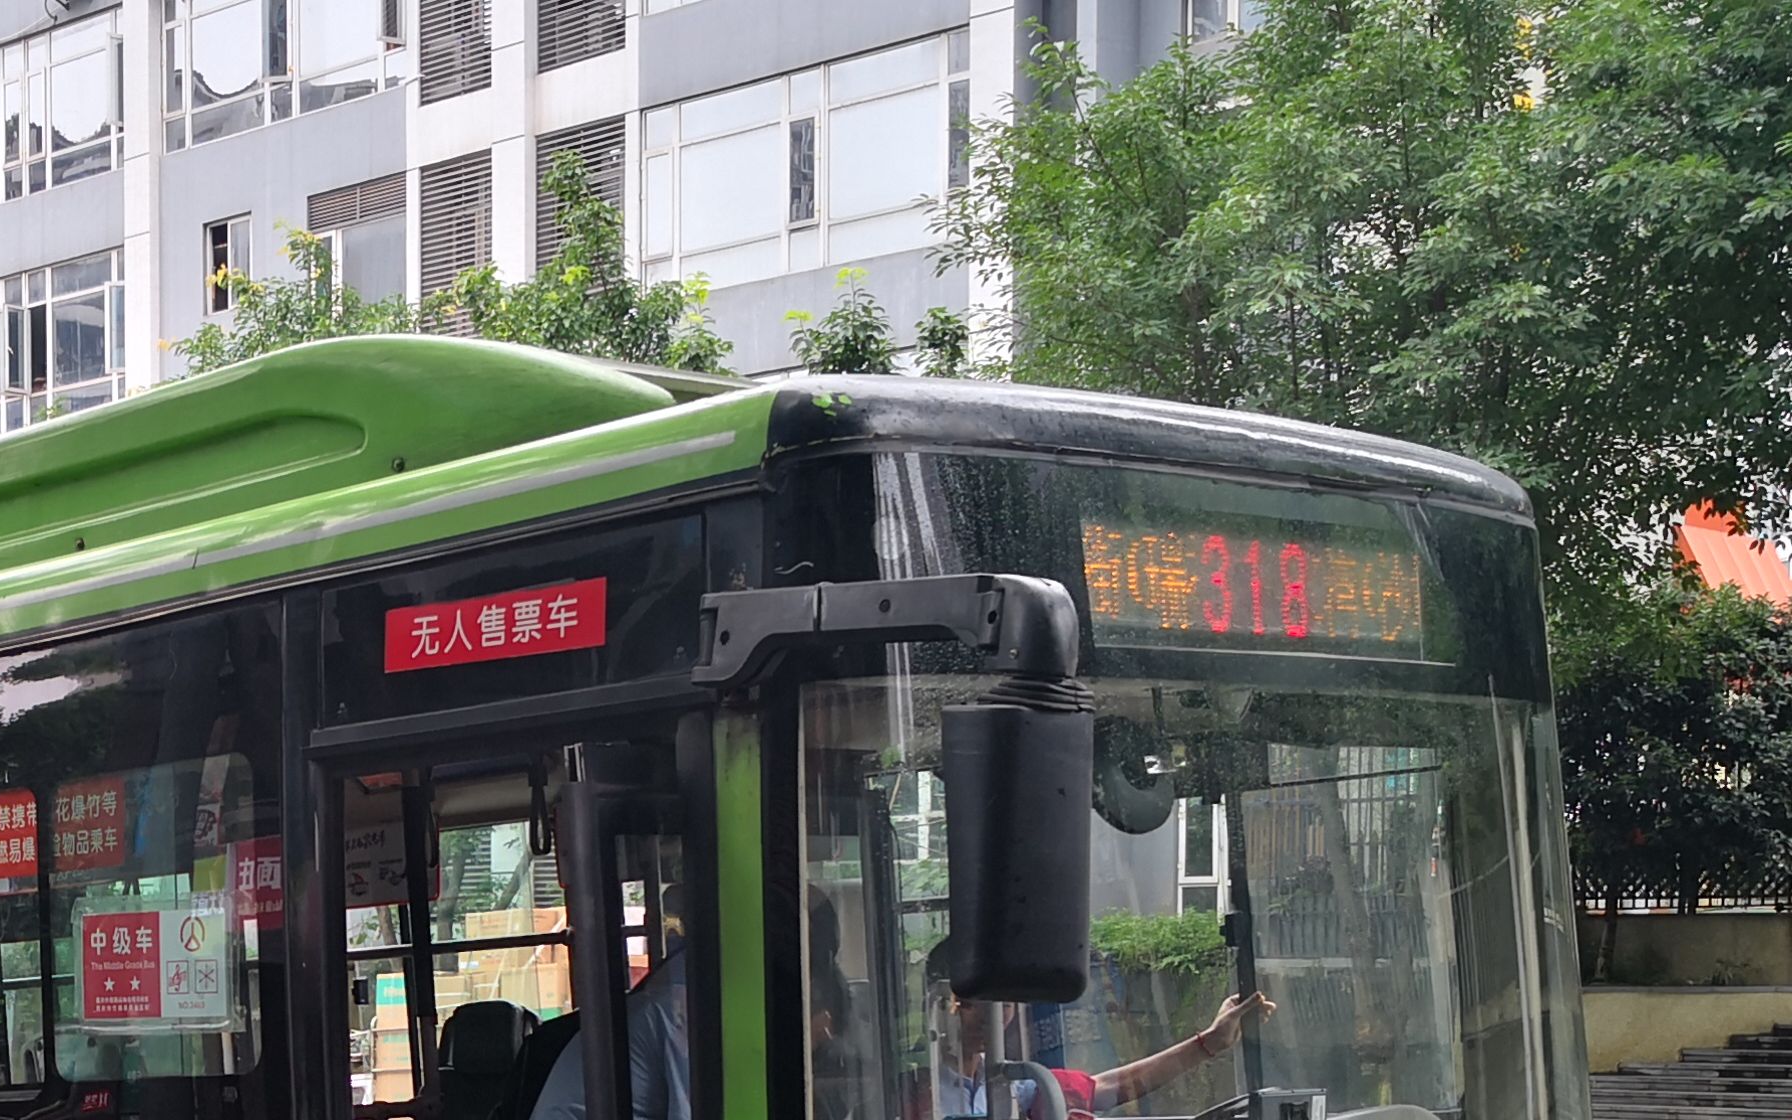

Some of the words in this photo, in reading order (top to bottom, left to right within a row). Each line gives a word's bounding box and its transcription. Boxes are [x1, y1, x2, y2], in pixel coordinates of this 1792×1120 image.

[1202, 534, 1308, 638] 318
[411, 594, 578, 659] 无人售票车
[90, 926, 153, 956] 中级车
